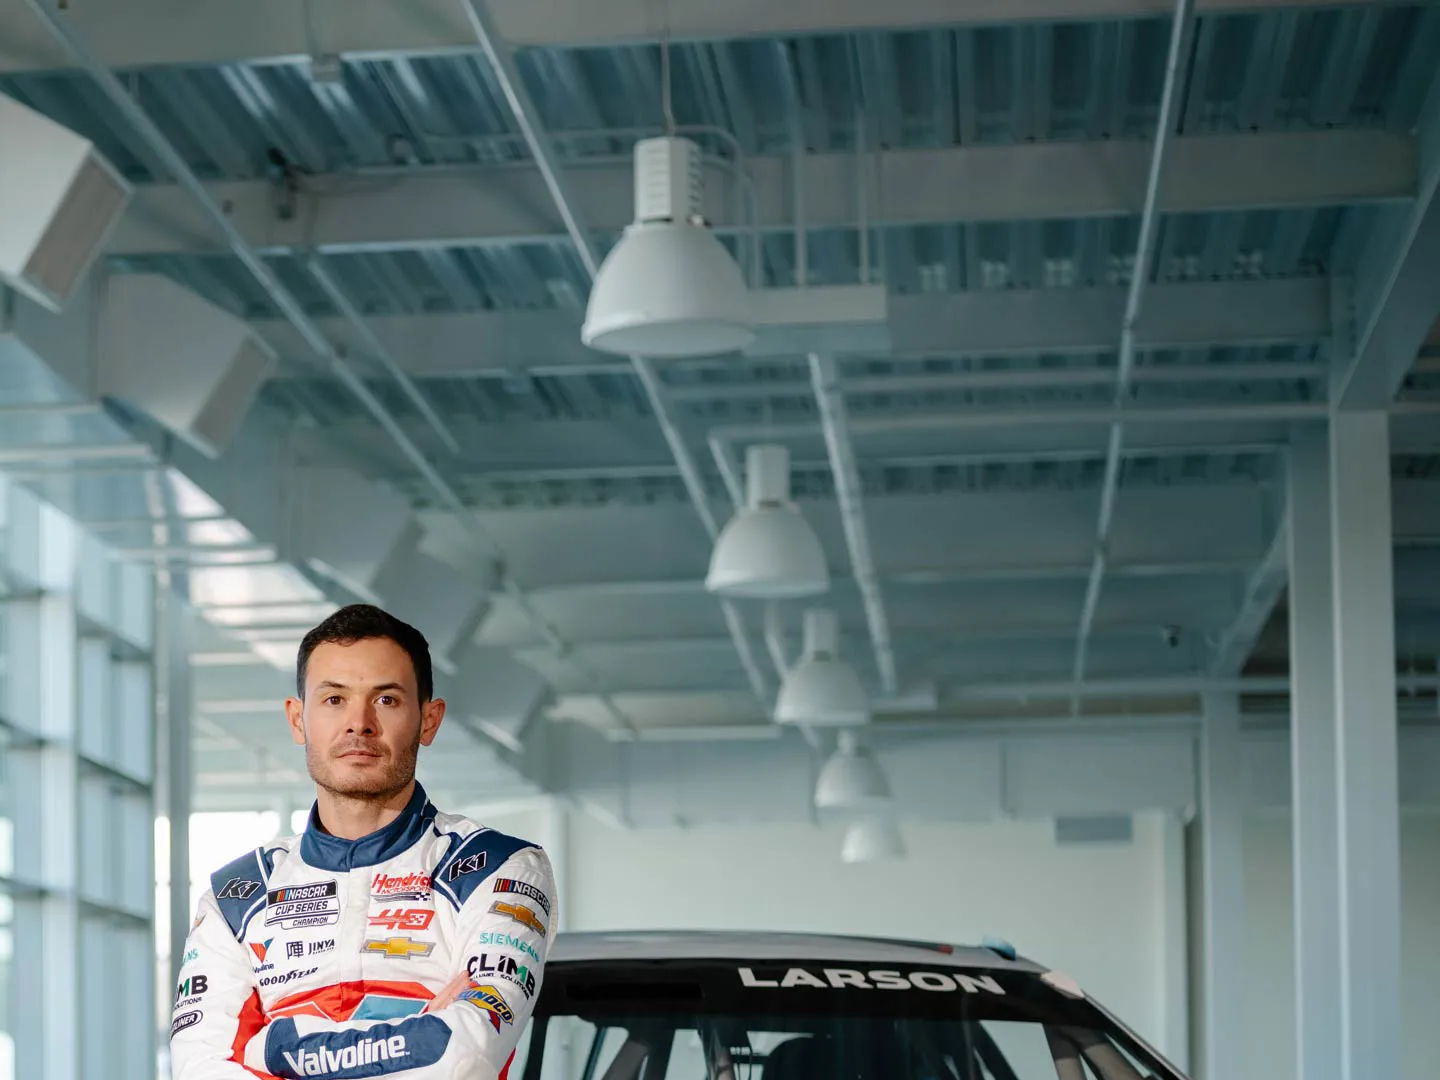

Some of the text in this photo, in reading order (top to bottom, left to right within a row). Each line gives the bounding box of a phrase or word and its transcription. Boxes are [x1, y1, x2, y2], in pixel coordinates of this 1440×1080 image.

[449, 851, 487, 882] K1
[216, 877, 262, 900] K1
[288, 885, 328, 900] NASCAR
[275, 900, 328, 916] CUP SERIES
[292, 916, 329, 927] CHAMPION
[308, 938, 335, 956] JINYA
[479, 931, 539, 963] SIEMEN
[467, 953, 535, 997] CLIMB
[738, 967, 1006, 995] LARSON
[283, 1034, 406, 1078] Valvoline
